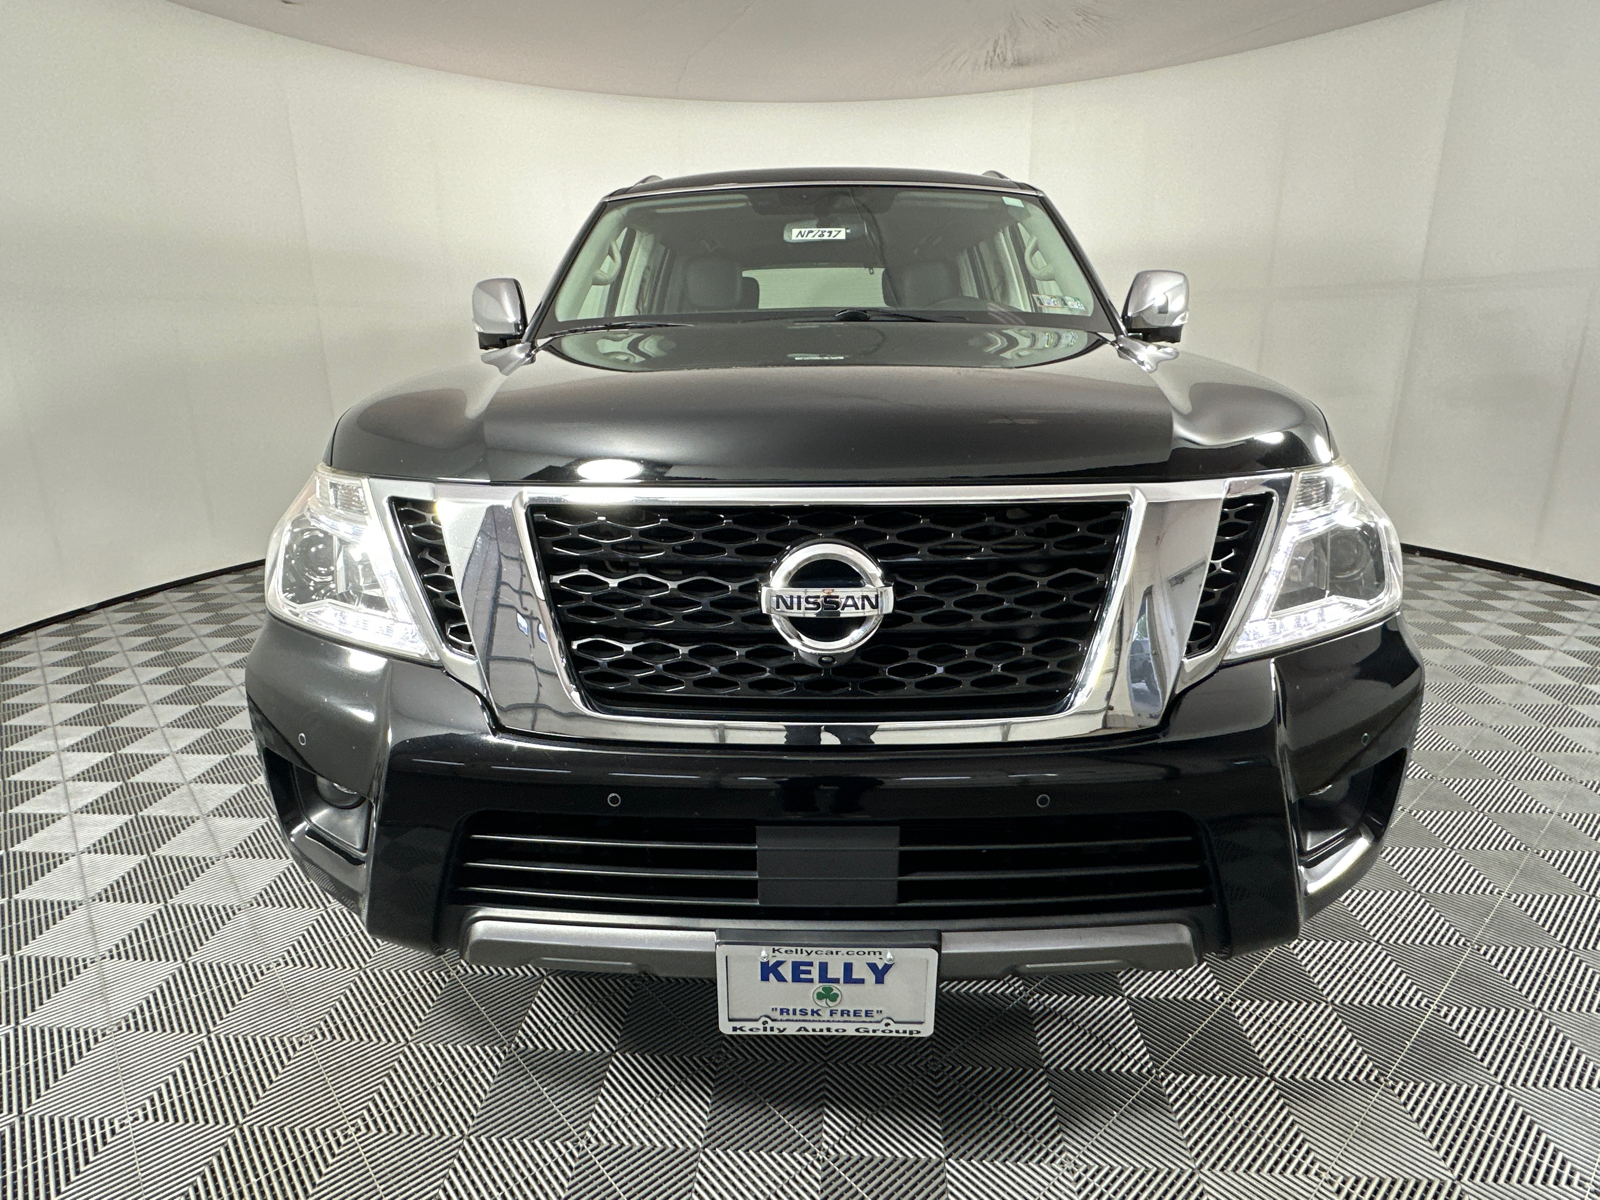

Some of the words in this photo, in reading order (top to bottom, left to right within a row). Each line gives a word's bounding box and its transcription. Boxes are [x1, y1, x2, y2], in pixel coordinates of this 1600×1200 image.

[775, 594, 879, 611] NISSAN
[772, 947, 882, 957] Kellycar.com
[760, 960, 895, 985] KELLY
[771, 1007, 822, 1017] "RISK
[829, 1008, 883, 1018] FREE"
[731, 1026, 788, 1034] Kelly
[795, 1026, 847, 1034] Auto
[854, 1027, 922, 1036] Group
